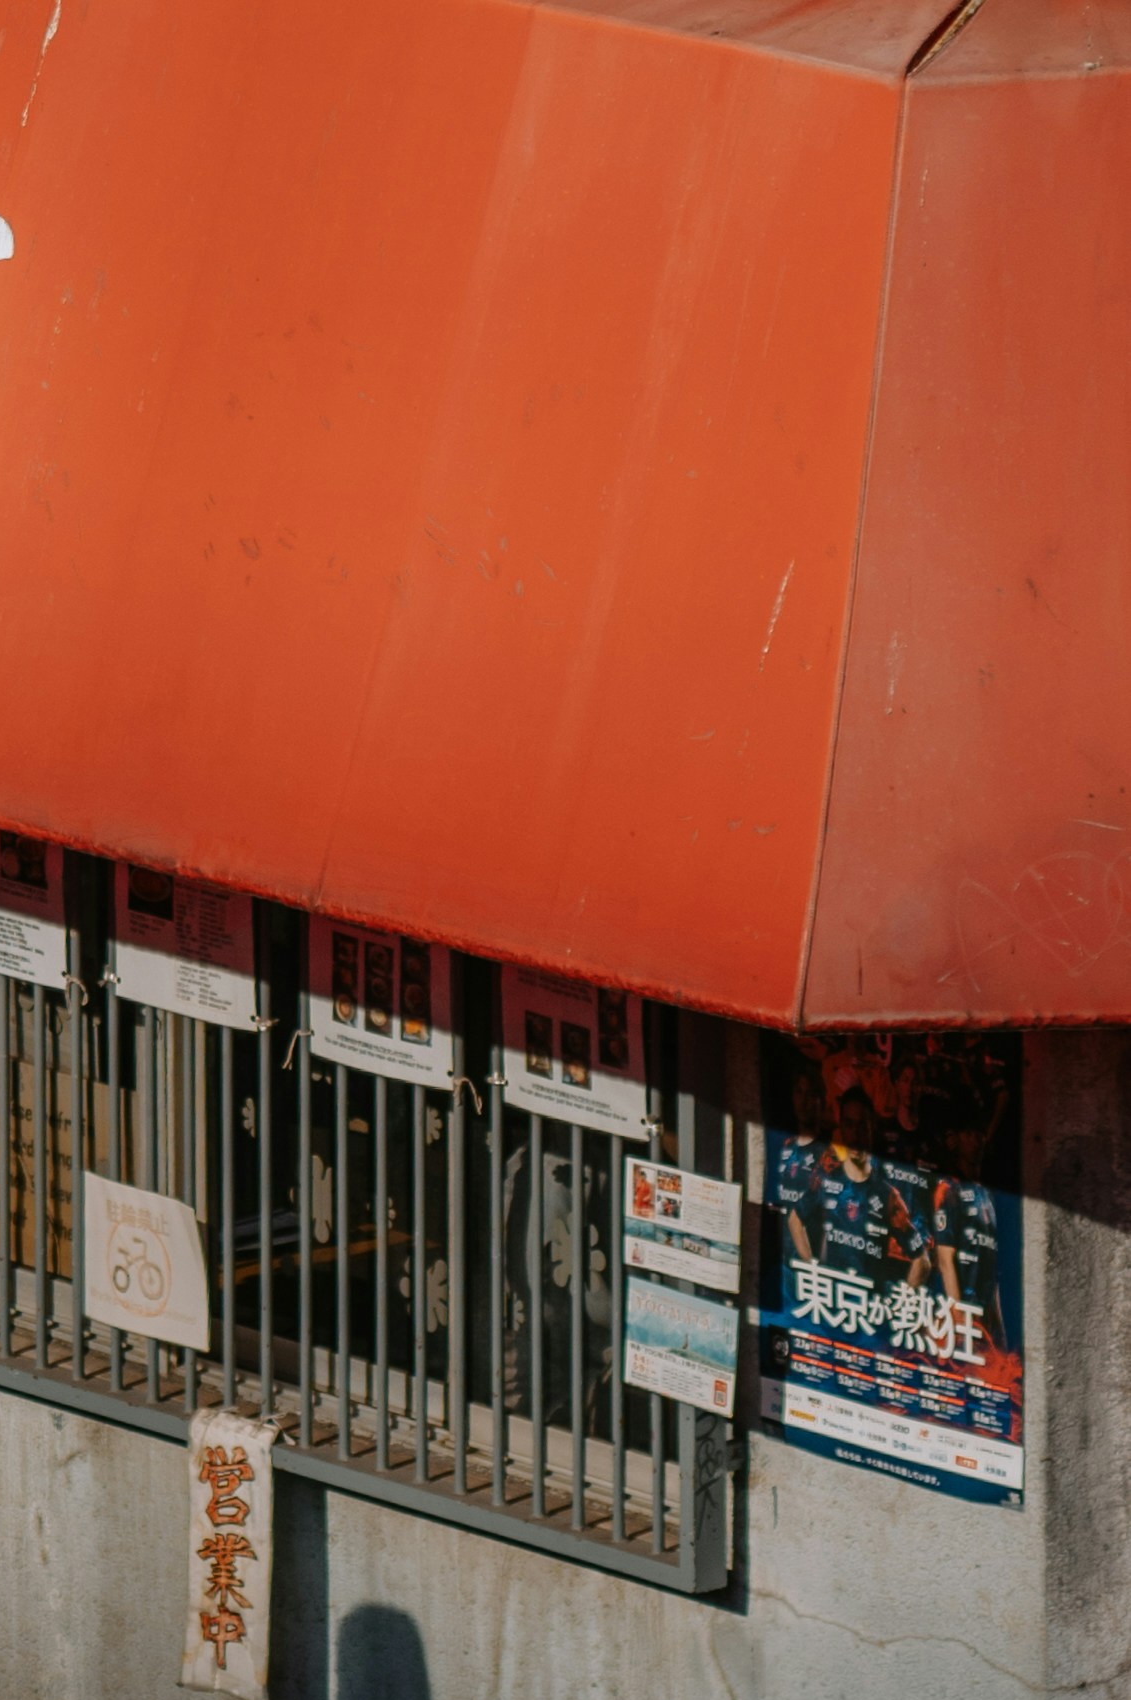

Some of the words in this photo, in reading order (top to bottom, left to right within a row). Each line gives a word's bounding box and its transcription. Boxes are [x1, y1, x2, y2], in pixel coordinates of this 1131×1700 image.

[832, 1228, 866, 1251] TOKYO
[791, 1257, 986, 1366] 東京が熱狂
[197, 1445, 257, 1670] 営業中
